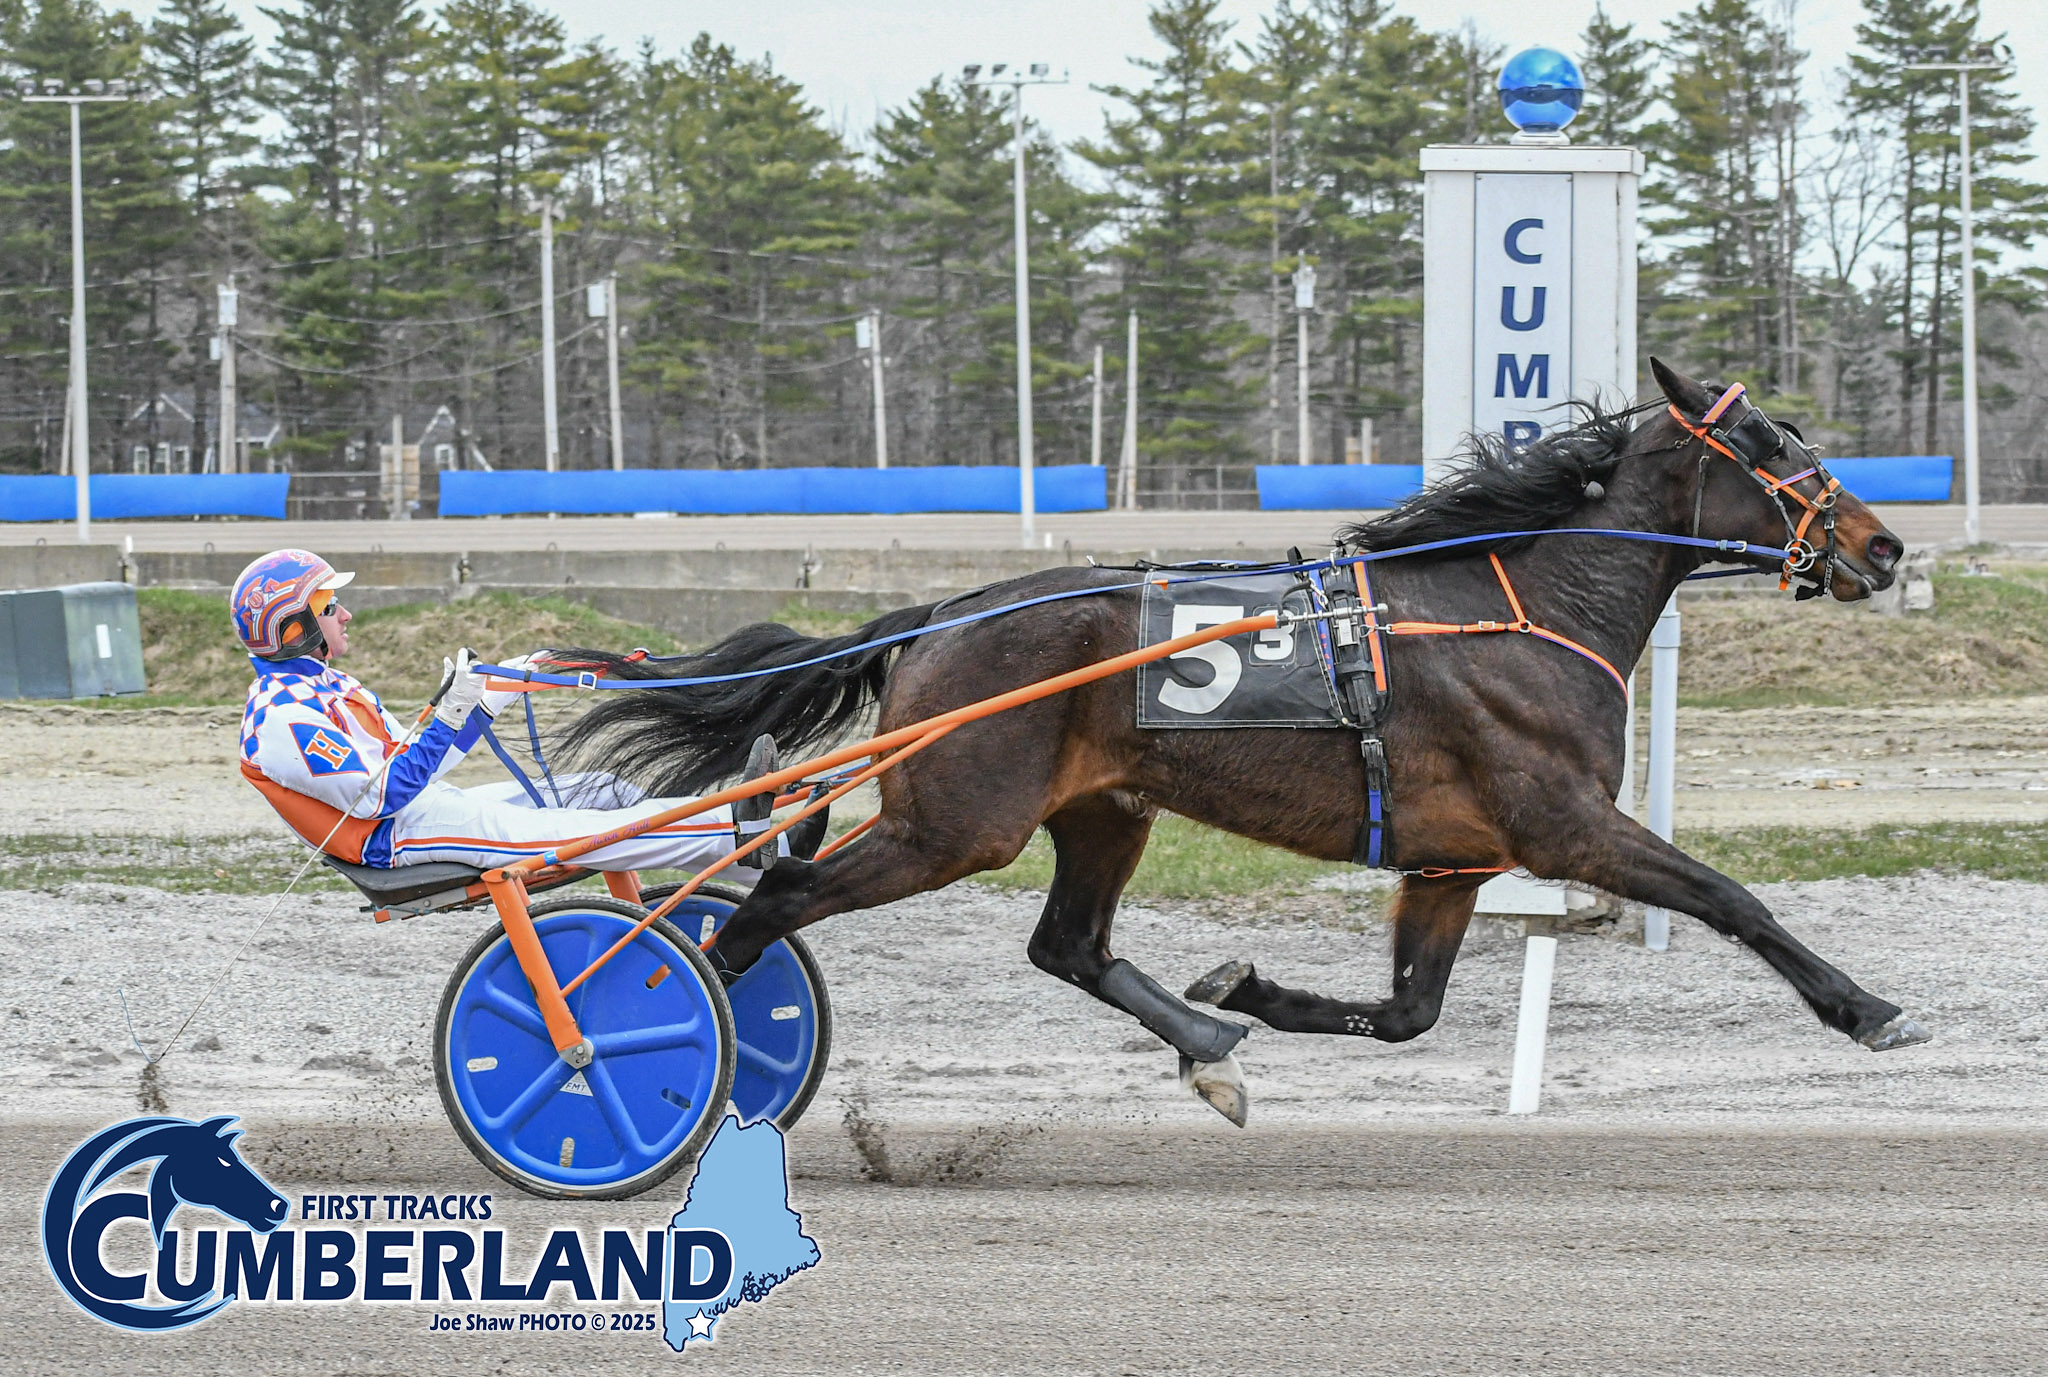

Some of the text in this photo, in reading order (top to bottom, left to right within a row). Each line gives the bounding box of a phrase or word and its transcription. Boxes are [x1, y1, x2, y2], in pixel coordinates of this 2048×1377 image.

[1158, 604, 1244, 714] 5
[1254, 609, 1294, 660] 3
[305, 728, 351, 770] H
